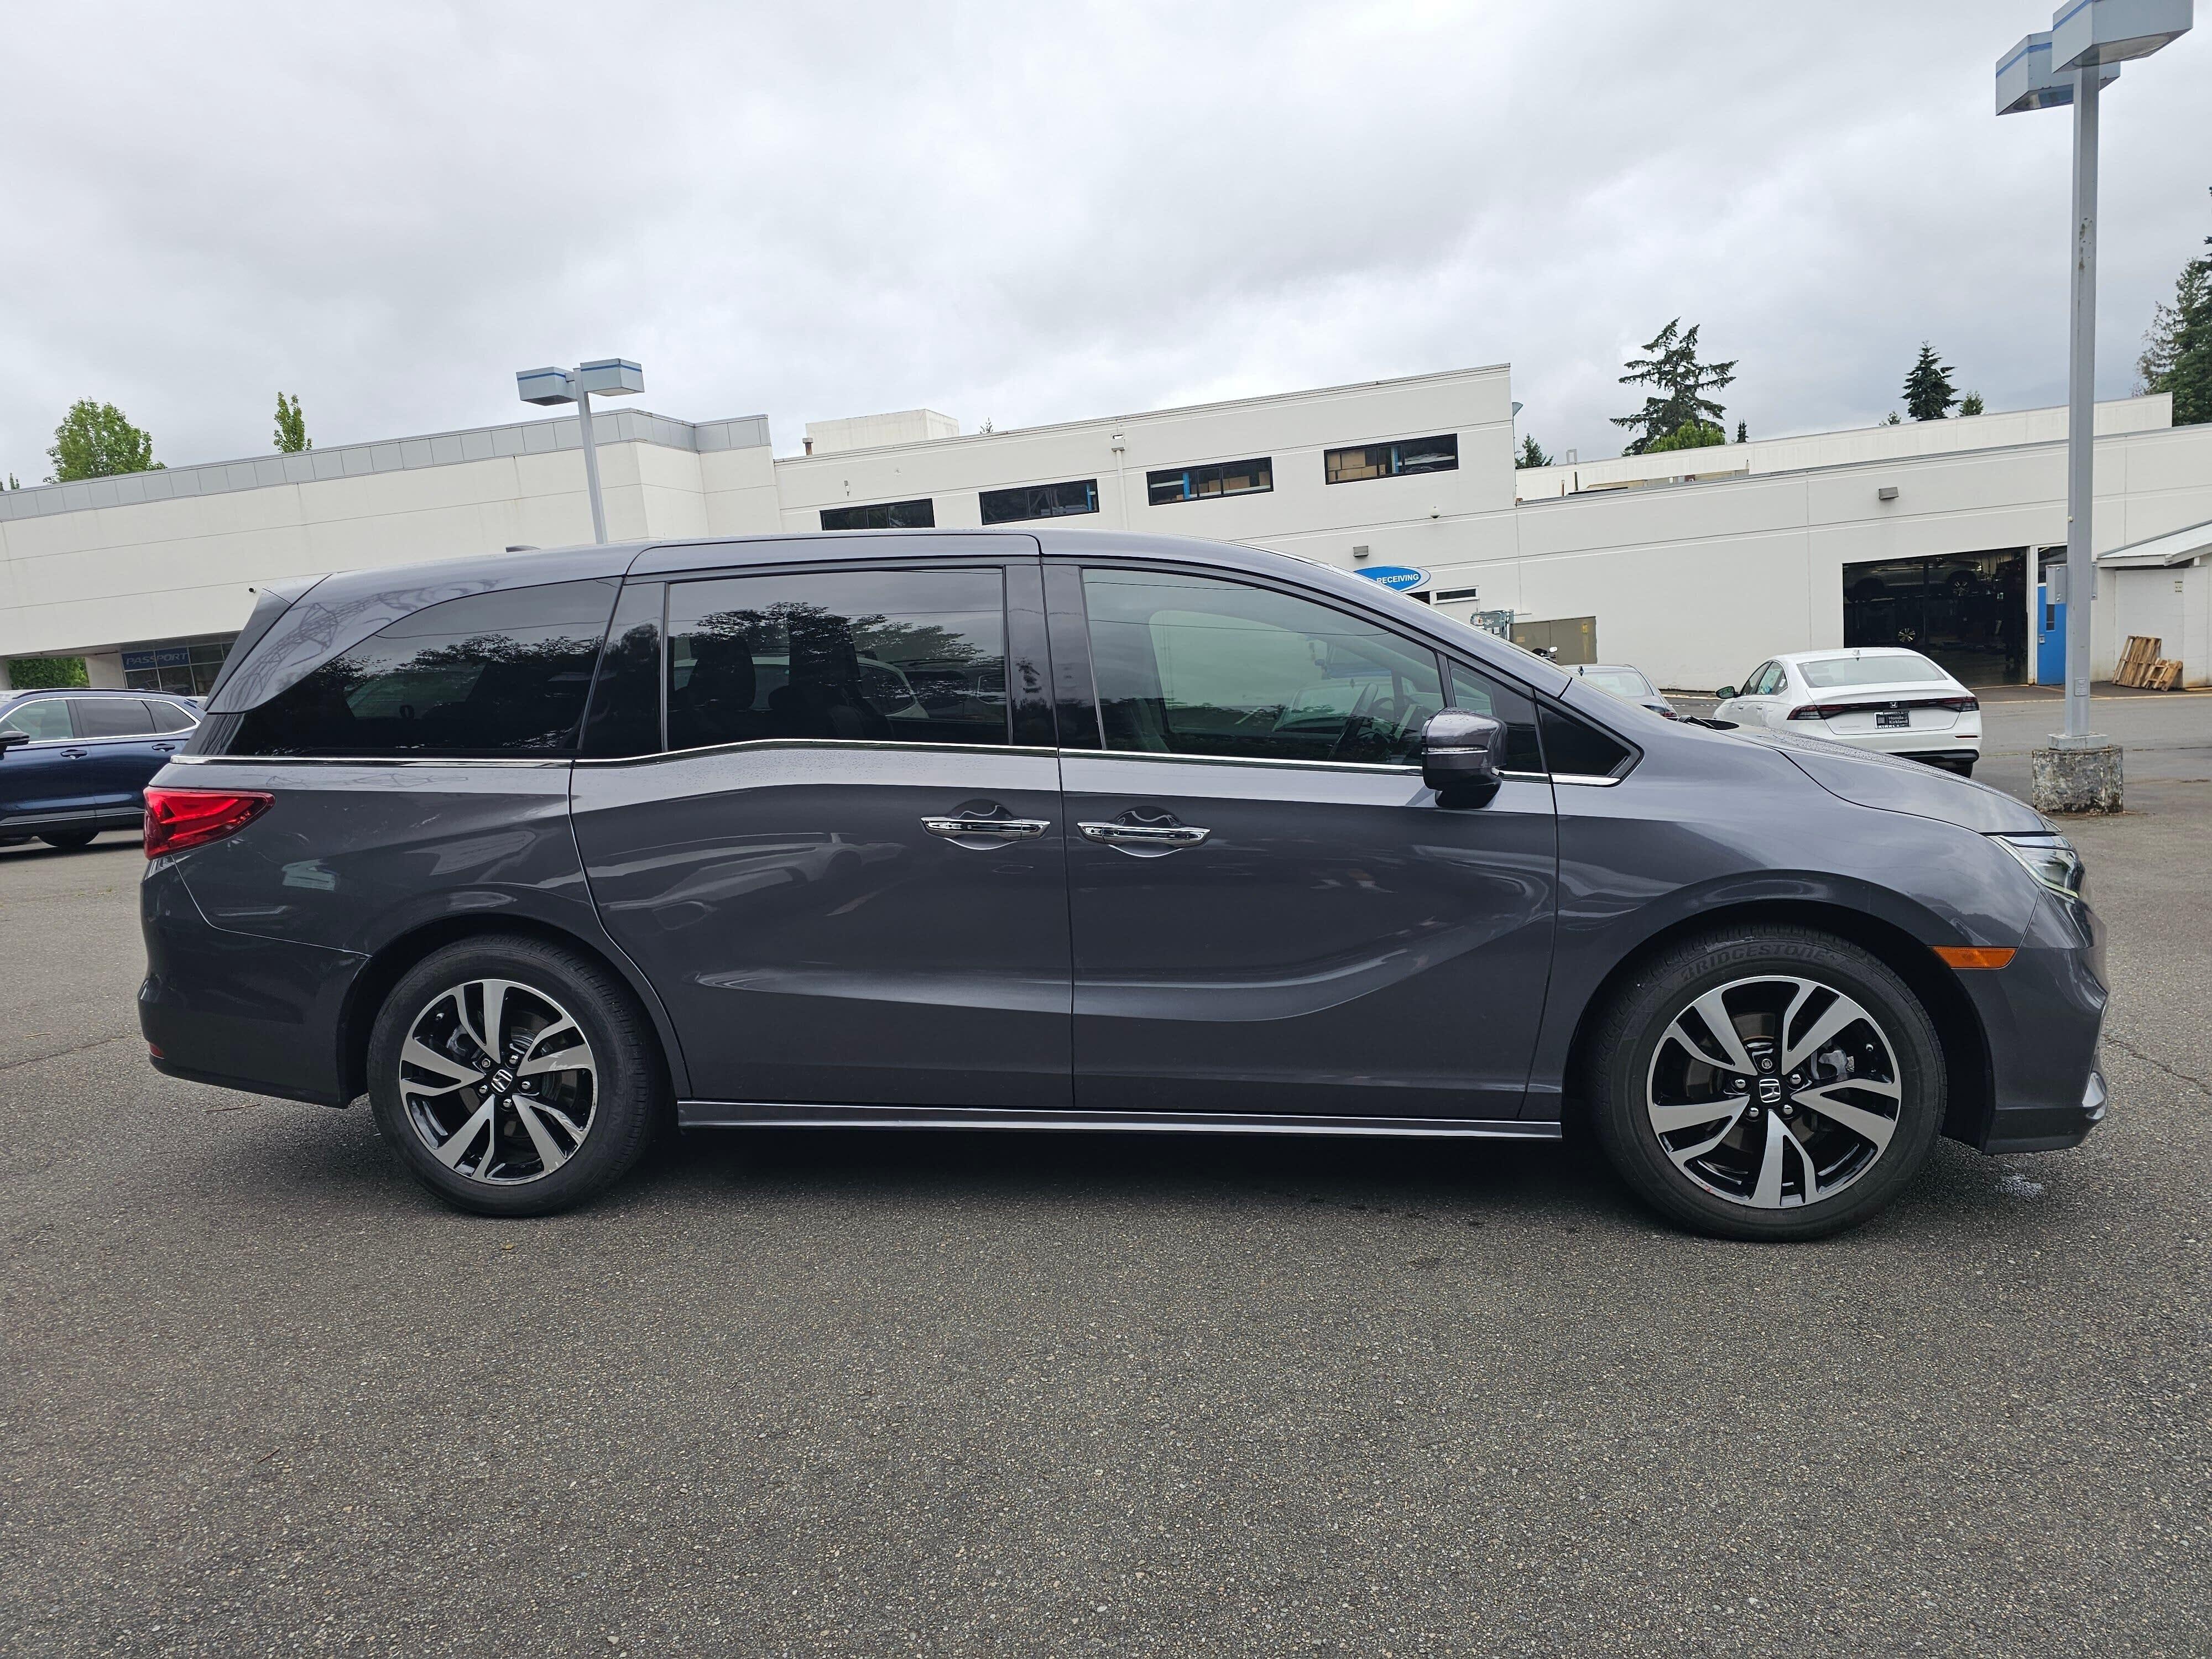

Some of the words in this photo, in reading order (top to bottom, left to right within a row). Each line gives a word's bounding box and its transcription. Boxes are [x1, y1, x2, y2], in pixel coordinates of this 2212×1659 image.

[1376, 574, 1419, 584] RECEIVING
[126, 653, 188, 665] PASSPORT
[1680, 943, 1829, 983] BRIDGESTONE
